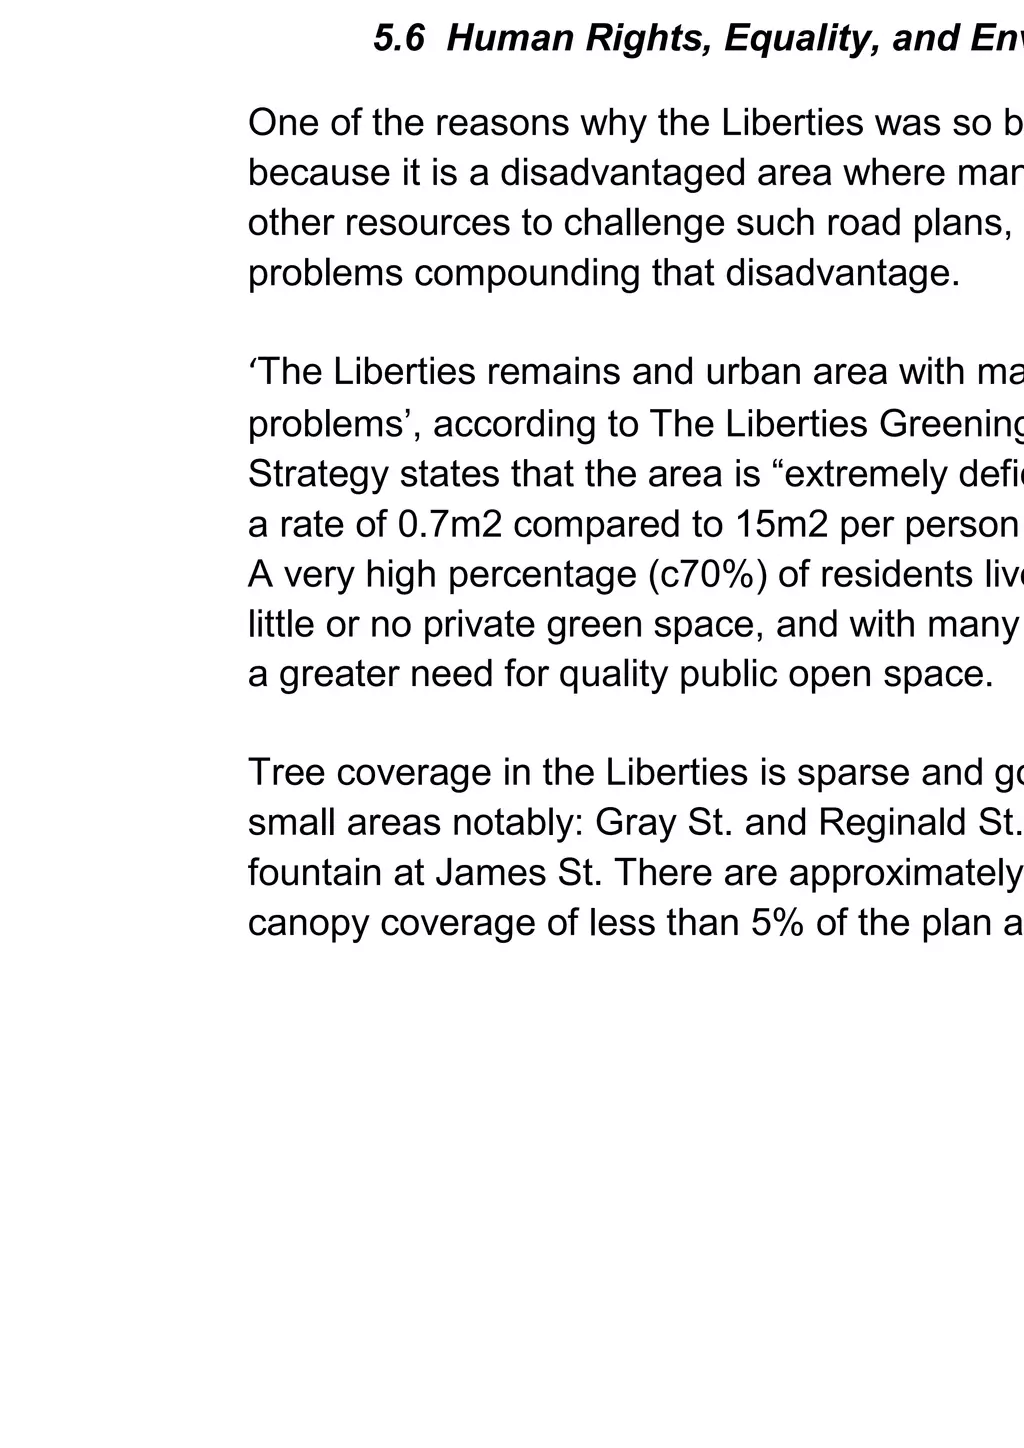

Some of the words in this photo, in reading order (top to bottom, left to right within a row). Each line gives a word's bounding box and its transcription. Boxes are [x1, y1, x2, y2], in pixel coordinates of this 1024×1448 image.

[373, 22, 426, 52] 5.6
[446, 22, 574, 52] Human
[585, 22, 711, 59] Rights,
[724, 22, 879, 59] Equality,
[892, 22, 962, 52] and
[249, 106, 319, 136] One
[331, 106, 364, 136] of
[372, 107, 424, 136] the
[437, 114, 570, 137] reasons
[580, 107, 648, 144] why
[657, 107, 710, 136] the
[723, 107, 864, 137] Liberties
[874, 114, 941, 137] was
[953, 114, 992, 137] so
[249, 157, 390, 186] because
[403, 157, 421, 186] it
[432, 157, 458, 186] is
[469, 164, 489, 186] a
[501, 157, 745, 194] disadvantaged
[757, 164, 832, 186] area
[843, 157, 946, 186] where
[248, 207, 336, 236] other
[346, 214, 511, 236] resources
[521, 208, 553, 236] to
[564, 207, 725, 244] challenge
[736, 207, 815, 236] such
[828, 207, 901, 236] road
[914, 207, 1011, 244] plans,
[249, 257, 403, 294] problems
[414, 257, 640, 294] compounding
[651, 257, 715, 287] that
[726, 257, 959, 294] disadvantage.
[249, 408, 420, 445] problems’,
[433, 408, 595, 445] according
[607, 409, 639, 438] to
[649, 408, 714, 438] The
[727, 408, 868, 438] Liberties
[248, 665, 268, 688] a
[279, 659, 401, 695] greater
[411, 658, 493, 688] need
[504, 657, 550, 688] for
[559, 658, 669, 695] quality
[680, 658, 778, 695] public
[789, 665, 871, 695] open
[884, 665, 992, 695] space.
[248, 756, 325, 786] Tree
[337, 764, 492, 794] coverage
[504, 756, 531, 786] in
[542, 756, 595, 786] the
[607, 756, 748, 786] Liberties
[761, 756, 786, 786] is
[797, 764, 910, 793] sparse
[922, 757, 983, 786] and
[248, 806, 335, 836] small
[347, 813, 441, 836] areas
[453, 806, 582, 844] notably:
[596, 806, 677, 844] Gray
[688, 806, 732, 836] St.
[745, 806, 806, 836] and
[820, 806, 965, 844] Reginald
[248, 914, 370, 944] canopy
[381, 914, 536, 944] coverage
[547, 906, 580, 936] of
[590, 907, 656, 937] less
[666, 907, 739, 936] than
[751, 906, 804, 937] 5%
[816, 906, 849, 936] of
[857, 907, 910, 936] the
[923, 907, 991, 944] plan
